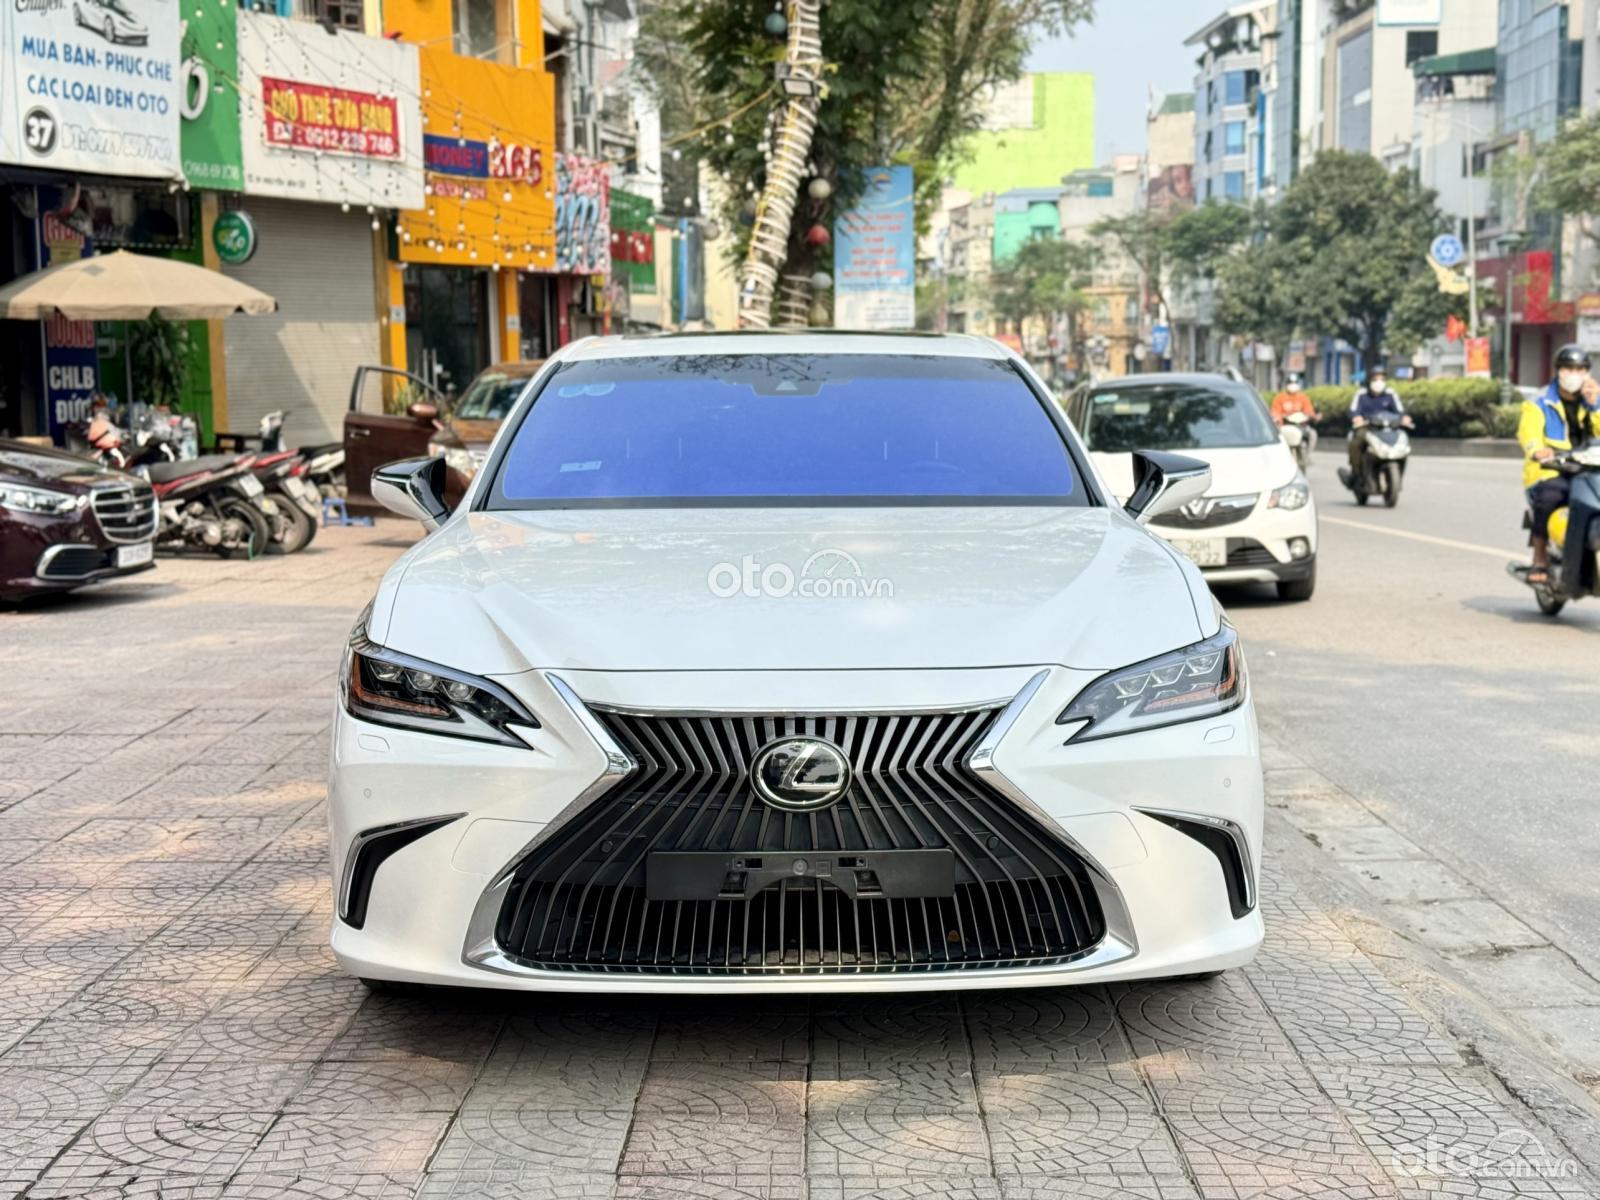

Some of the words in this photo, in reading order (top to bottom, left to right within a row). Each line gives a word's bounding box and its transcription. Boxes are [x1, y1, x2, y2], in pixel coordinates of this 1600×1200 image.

[22, 36, 58, 60] MUA
[27, 116, 53, 148] 37
[50, 366, 94, 390] CHLB
